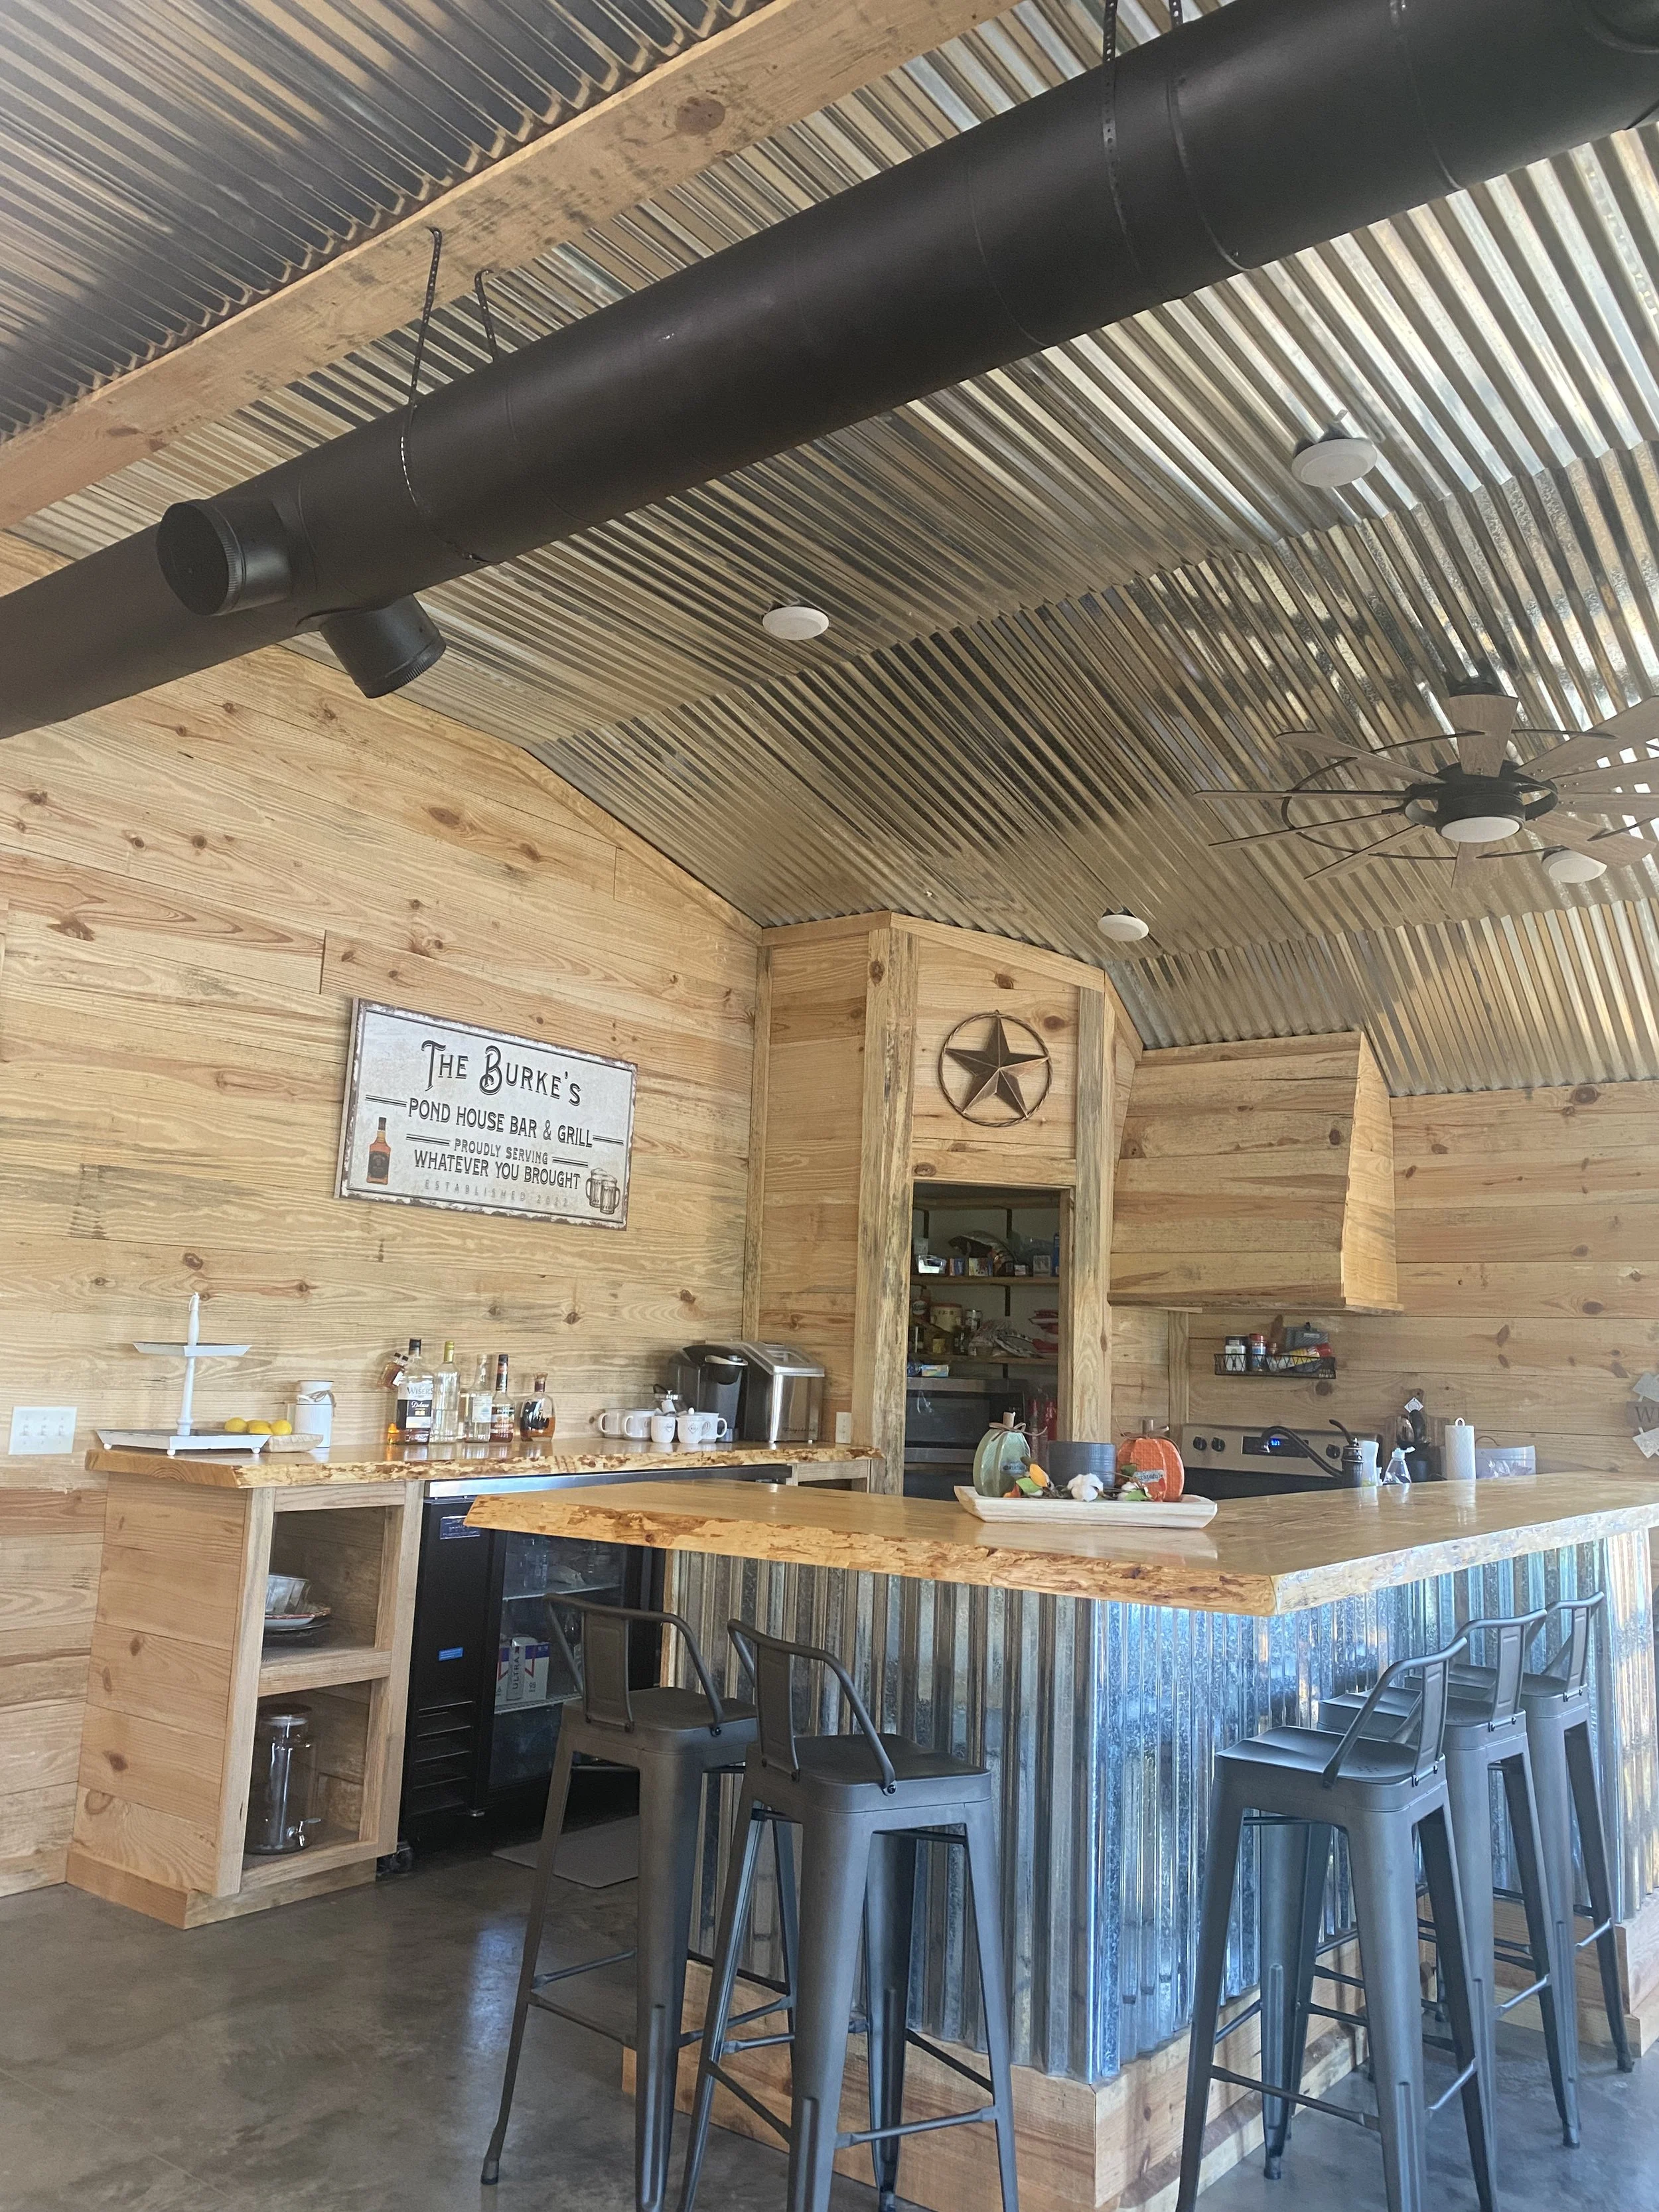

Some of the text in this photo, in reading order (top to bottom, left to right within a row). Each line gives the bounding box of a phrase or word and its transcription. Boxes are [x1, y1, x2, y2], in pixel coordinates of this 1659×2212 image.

[421, 1040, 581, 1106] THE BURKE'S
[408, 1098, 593, 1148] POND HOUSE BAR & GRILL
[454, 1138, 549, 1165] PROUDLY SERVING
[415, 1149, 581, 1189] WHATEVER YOU BROUGHT
[425, 1179, 569, 1207] ESTABLISHED 2022
[1634, 1406, 1659, 1424] W
[1135, 1472, 1161, 1481] rateful
